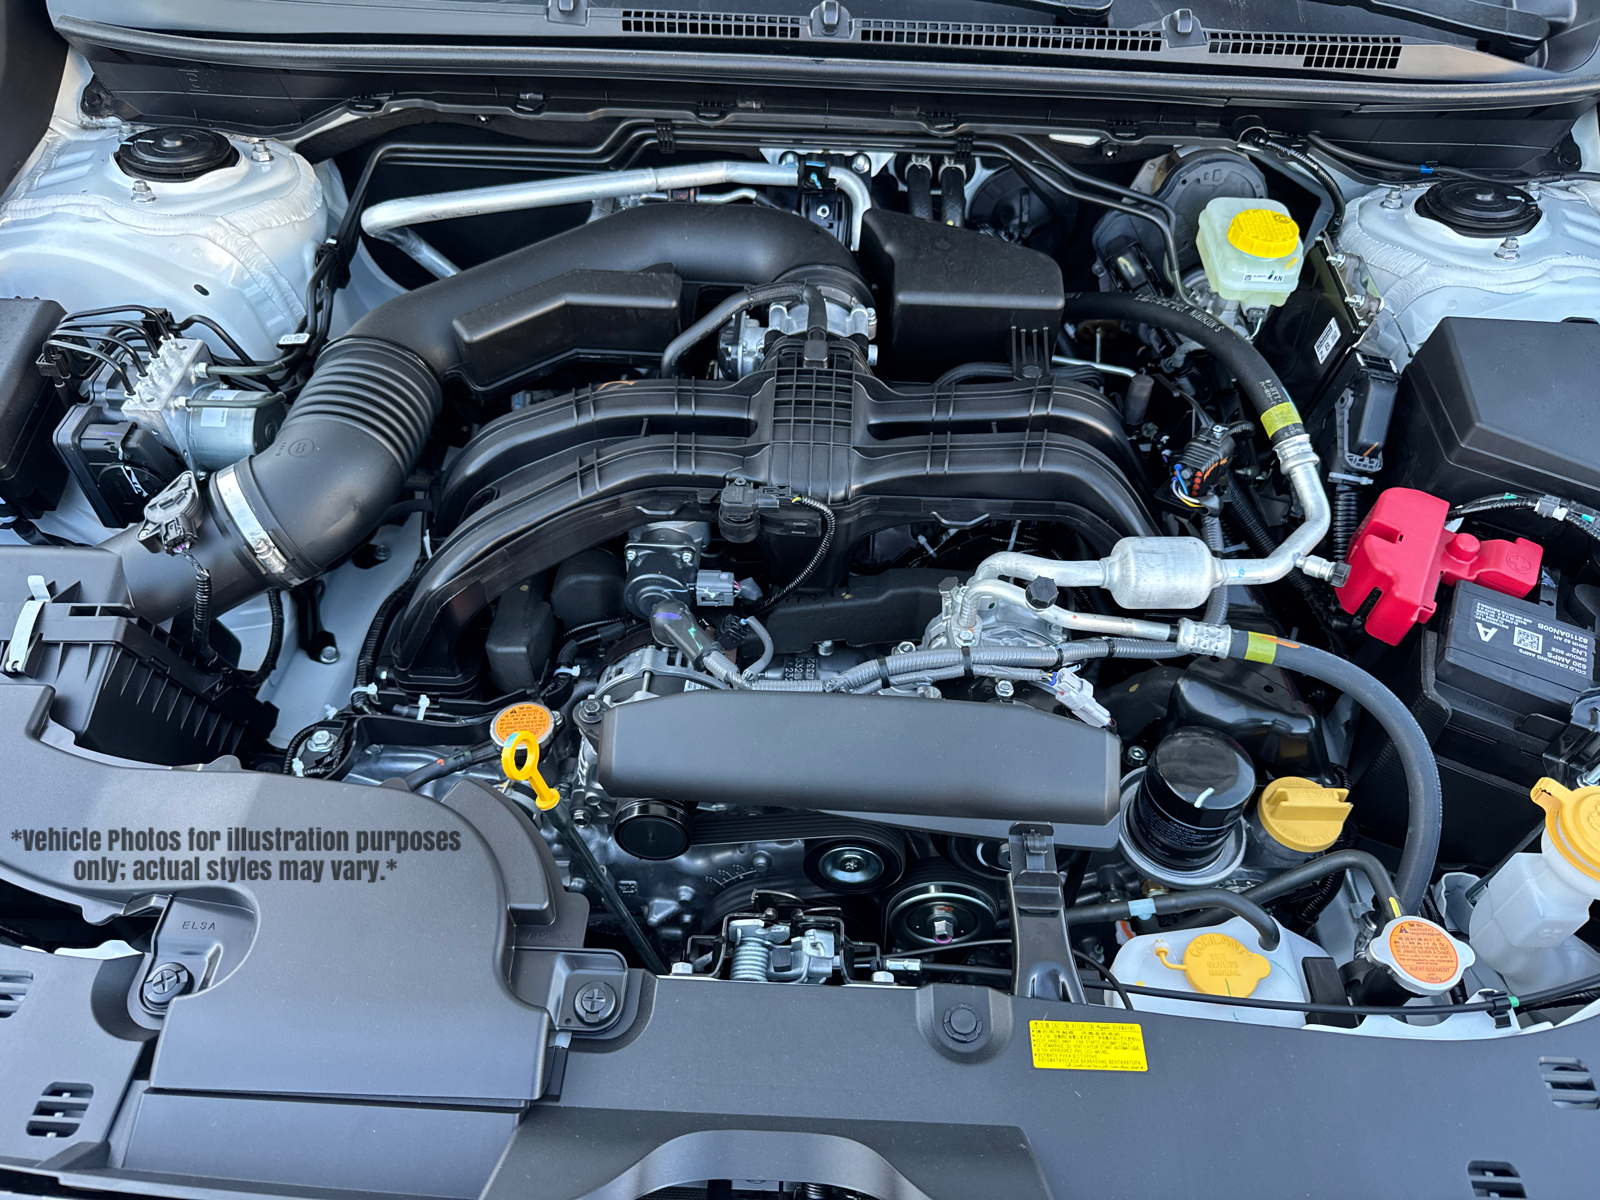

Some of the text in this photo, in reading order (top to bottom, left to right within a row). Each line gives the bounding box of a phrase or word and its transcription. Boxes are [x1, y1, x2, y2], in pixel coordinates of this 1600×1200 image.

[1551, 647, 1587, 662] GROUP SIZE
[1571, 647, 1588, 657] LN2
[1519, 649, 1587, 675] COLD CRANKING AMPS
[1546, 652, 1587, 670] 620 AMPS
[1169, 820, 1197, 834] CAUTION
[181, 920, 217, 931] ELSA
[1189, 935, 1248, 957] COOLANT
